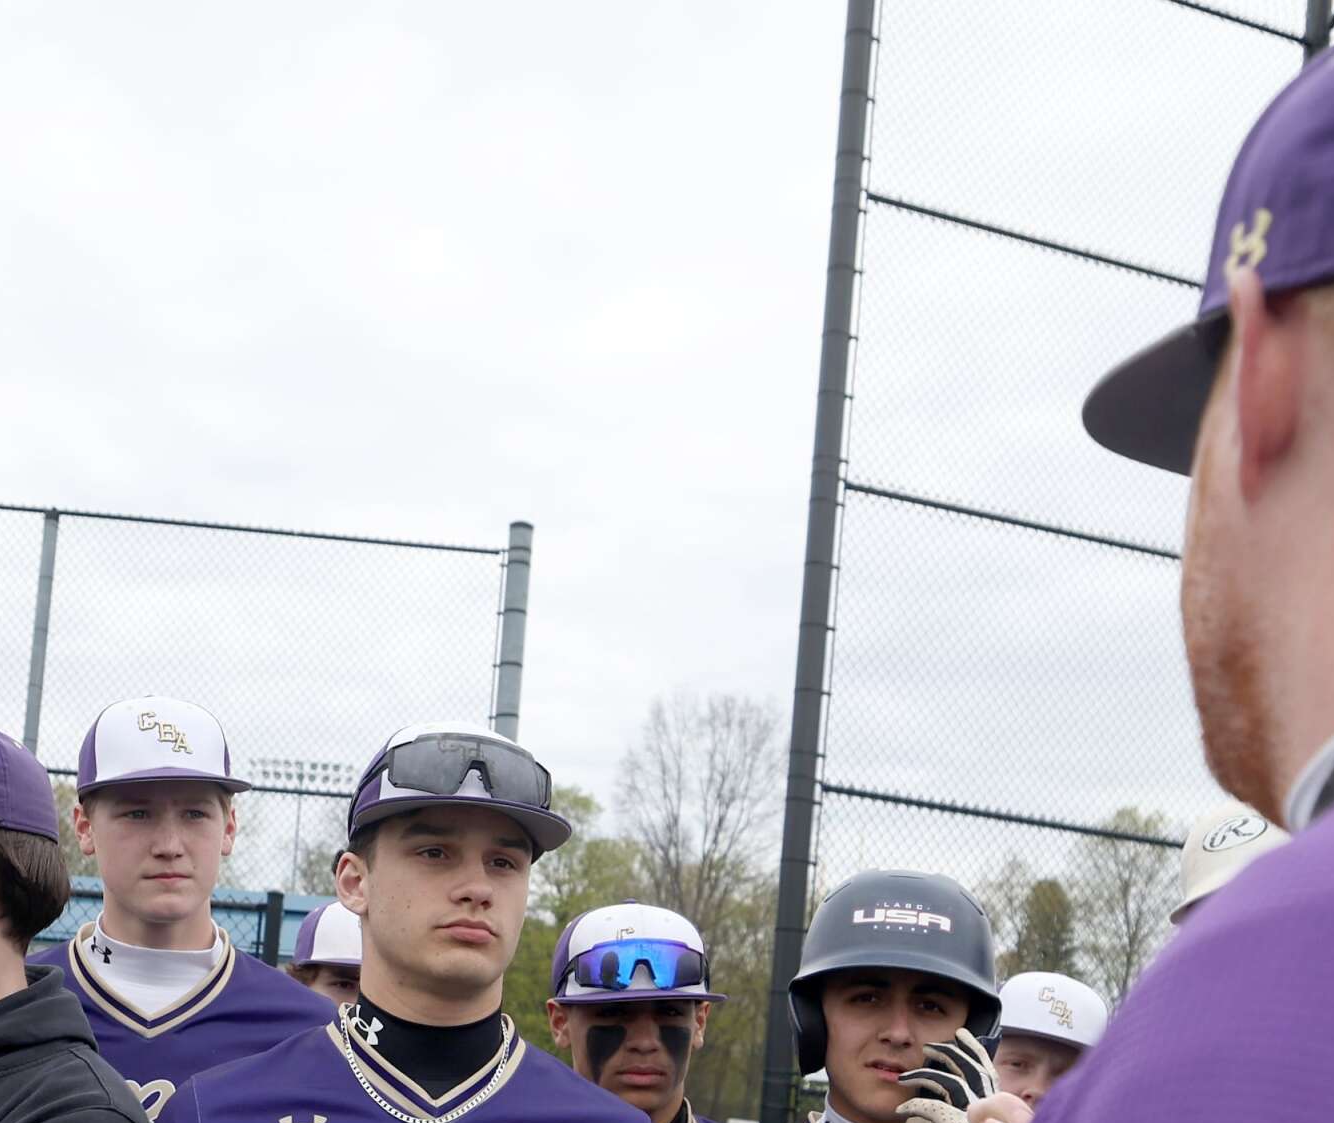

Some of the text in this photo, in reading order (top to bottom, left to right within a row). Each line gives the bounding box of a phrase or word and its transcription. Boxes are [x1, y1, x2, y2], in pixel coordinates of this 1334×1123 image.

[137, 711, 193, 755] CBA
[853, 908, 951, 933] USA
[1038, 987, 1073, 1029] CBA
